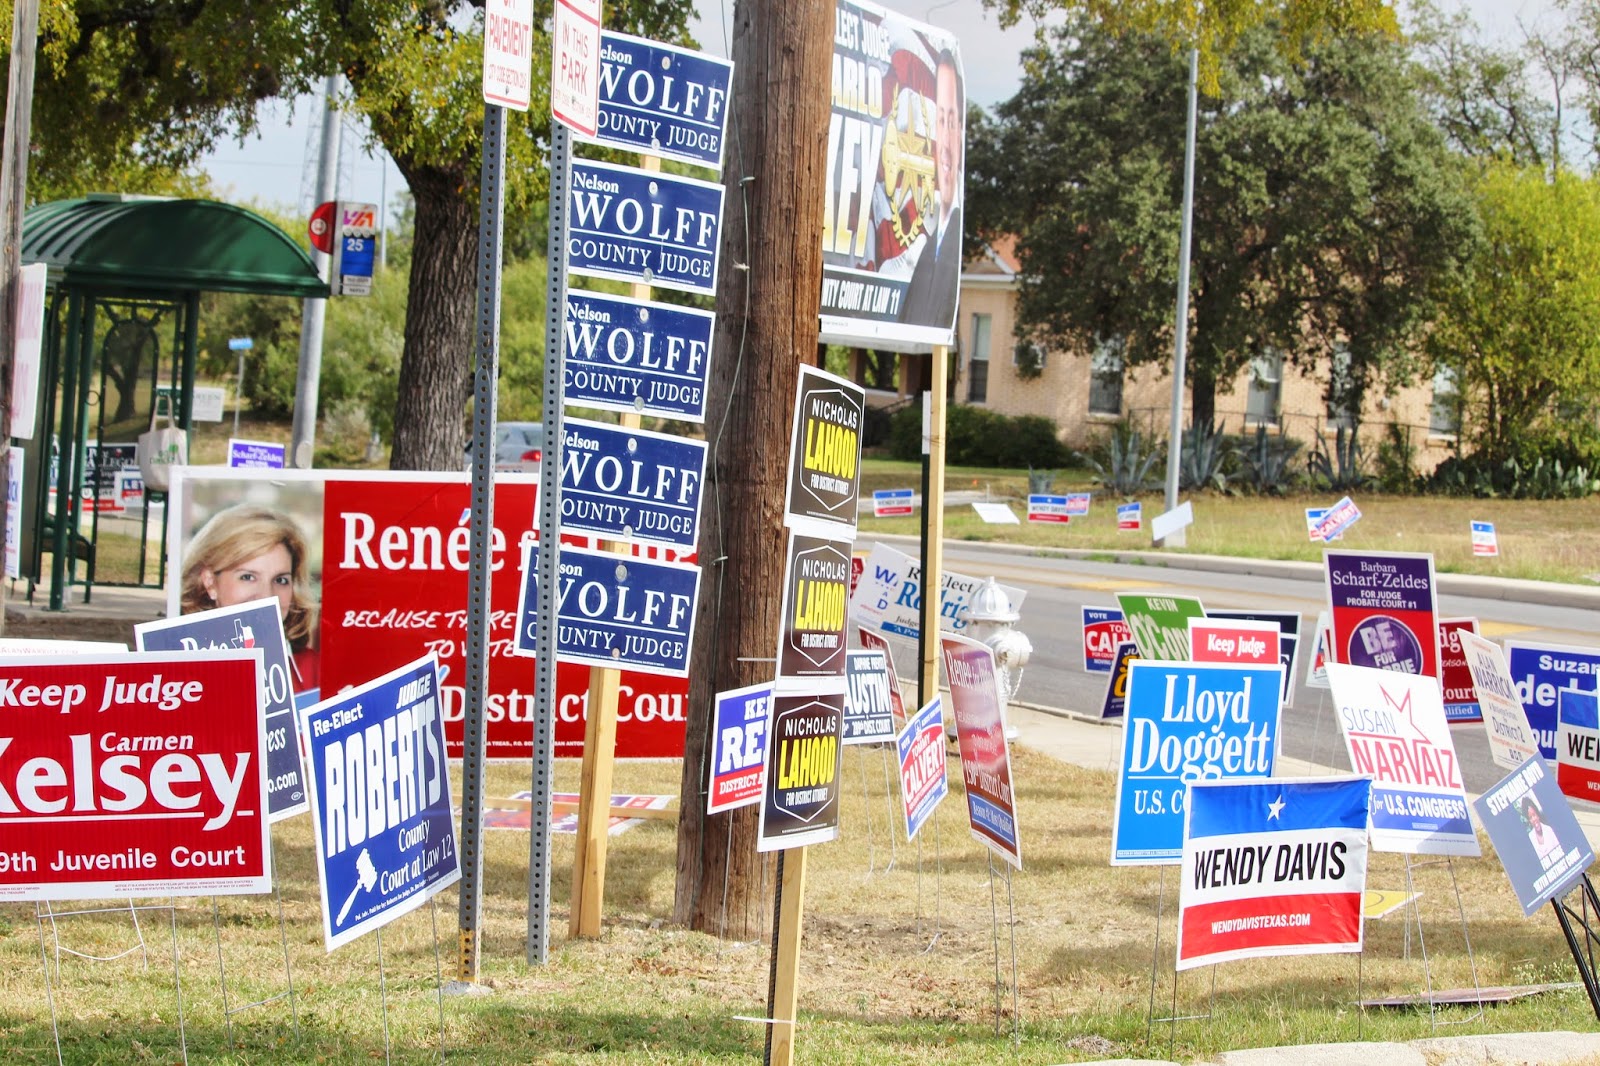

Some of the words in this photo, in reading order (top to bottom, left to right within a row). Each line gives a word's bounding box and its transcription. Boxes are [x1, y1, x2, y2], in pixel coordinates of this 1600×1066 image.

[489, 13, 529, 58] PAVEMENT
[562, 21, 570, 47] IN
[572, 28, 589, 59] THIS
[834, 7, 859, 51] LECT
[599, 44, 633, 65] elson
[561, 51, 588, 97] PARK
[832, 52, 883, 119] ARLO
[599, 63, 725, 123] WOLFF
[597, 110, 661, 140] OUNTY
[666, 124, 719, 153] JUDGE
[573, 171, 620, 195] Nelson
[573, 191, 717, 248] WOLFF
[346, 238, 364, 252] 25
[569, 239, 652, 267] COUNTY
[659, 251, 712, 278] JUDGE
[567, 301, 611, 323] Nelson
[822, 277, 840, 307] NTY
[838, 280, 864, 311] COURT
[862, 284, 874, 312] AT
[872, 286, 891, 314] LAW
[566, 320, 706, 376] WOLFF
[564, 369, 643, 397] COUNTY
[648, 381, 701, 406] JUDGE
[811, 398, 858, 430] NICHOLAS
[804, 418, 858, 481] LAHOOD
[561, 451, 699, 504] WOLFF
[810, 473, 820, 489] FOR
[819, 475, 836, 492] DISTRICT
[561, 498, 631, 525] OUNTY
[636, 509, 693, 536] JUDGE
[534, 555, 583, 577] son
[802, 558, 846, 581] NICHOLAS
[907, 566, 974, 593] RElect
[1332, 570, 1429, 590] Scharf-Zeldes
[1360, 561, 1397, 574] Barbara
[795, 579, 845, 632] LAHOOD
[1145, 598, 1178, 612] KEVIN
[1346, 597, 1380, 607] PROBATE
[1381, 600, 1407, 609] COURT
[1408, 601, 1417, 609] #1
[1360, 589, 1376, 598] FOR
[1377, 590, 1402, 600] JUDGE
[342, 608, 442, 629] BECAUSE
[444, 609, 518, 631] TRE
[1089, 612, 1107, 620] VOTE
[1109, 623, 1130, 634] TOM
[424, 638, 455, 659] TO
[462, 638, 516, 659] TE
[527, 621, 615, 650] CUNTY
[622, 634, 684, 660] JUDGE
[801, 633, 810, 648] FOR
[809, 633, 825, 648] DISTRICT
[1129, 611, 1189, 662] O'Con
[1207, 634, 1234, 656] Keep
[1237, 636, 1266, 658] Judge
[1359, 621, 1398, 656] BE
[1373, 650, 1397, 667] FOR
[1477, 651, 1498, 674] ALAN
[0, 679, 87, 714] Keep
[98, 674, 204, 713] Judge
[396, 673, 432, 710] JUDGE
[844, 673, 890, 715] AUSTIN
[1472, 664, 1516, 702] WARRICK
[1516, 673, 1556, 707] de
[443, 684, 588, 723] Dstrct
[616, 685, 689, 723] Cou
[744, 696, 769, 720] KE
[1162, 674, 1252, 730] Lloyd
[1445, 704, 1474, 716] lified
[313, 702, 363, 738] Re-Elect
[785, 716, 837, 737] NICHOLAS
[876, 718, 891, 734] COURT
[1342, 706, 1397, 735] SUSAN
[1492, 716, 1518, 741] DISTRICT
[1517, 726, 1526, 743] 2
[99, 732, 195, 752] Carmen
[719, 720, 767, 774] RE
[900, 735, 911, 751] VOTE
[912, 732, 931, 760] TOMMY
[1128, 717, 1270, 782] Doggett
[325, 696, 442, 858] ROBERTS
[778, 735, 837, 790] LAHOOD
[904, 733, 944, 804] CALVERT
[1350, 738, 1461, 788] NARVAIZ
[719, 773, 758, 795] DISTRICT
[785, 791, 795, 807] FOR
[794, 789, 812, 806] DISTRICT
[1486, 773, 1529, 816] STEPHANIE
[1522, 761, 1545, 788] BOYD
[1134, 790, 1166, 814] U.S.
[1372, 795, 1384, 815] for
[1384, 794, 1409, 816] U.S.
[1406, 796, 1467, 820] CONGRESS
[399, 819, 430, 853] County
[50, 848, 157, 872] Juvenile
[170, 846, 246, 868] Court
[380, 862, 410, 895] Court
[411, 856, 421, 881] at
[422, 844, 440, 879] Law
[441, 834, 453, 857] 12
[1195, 845, 1273, 890] WENDY
[1273, 841, 1348, 882] DAVIS
[1211, 912, 1311, 935] WENDYDAVISTEXAS.COM
